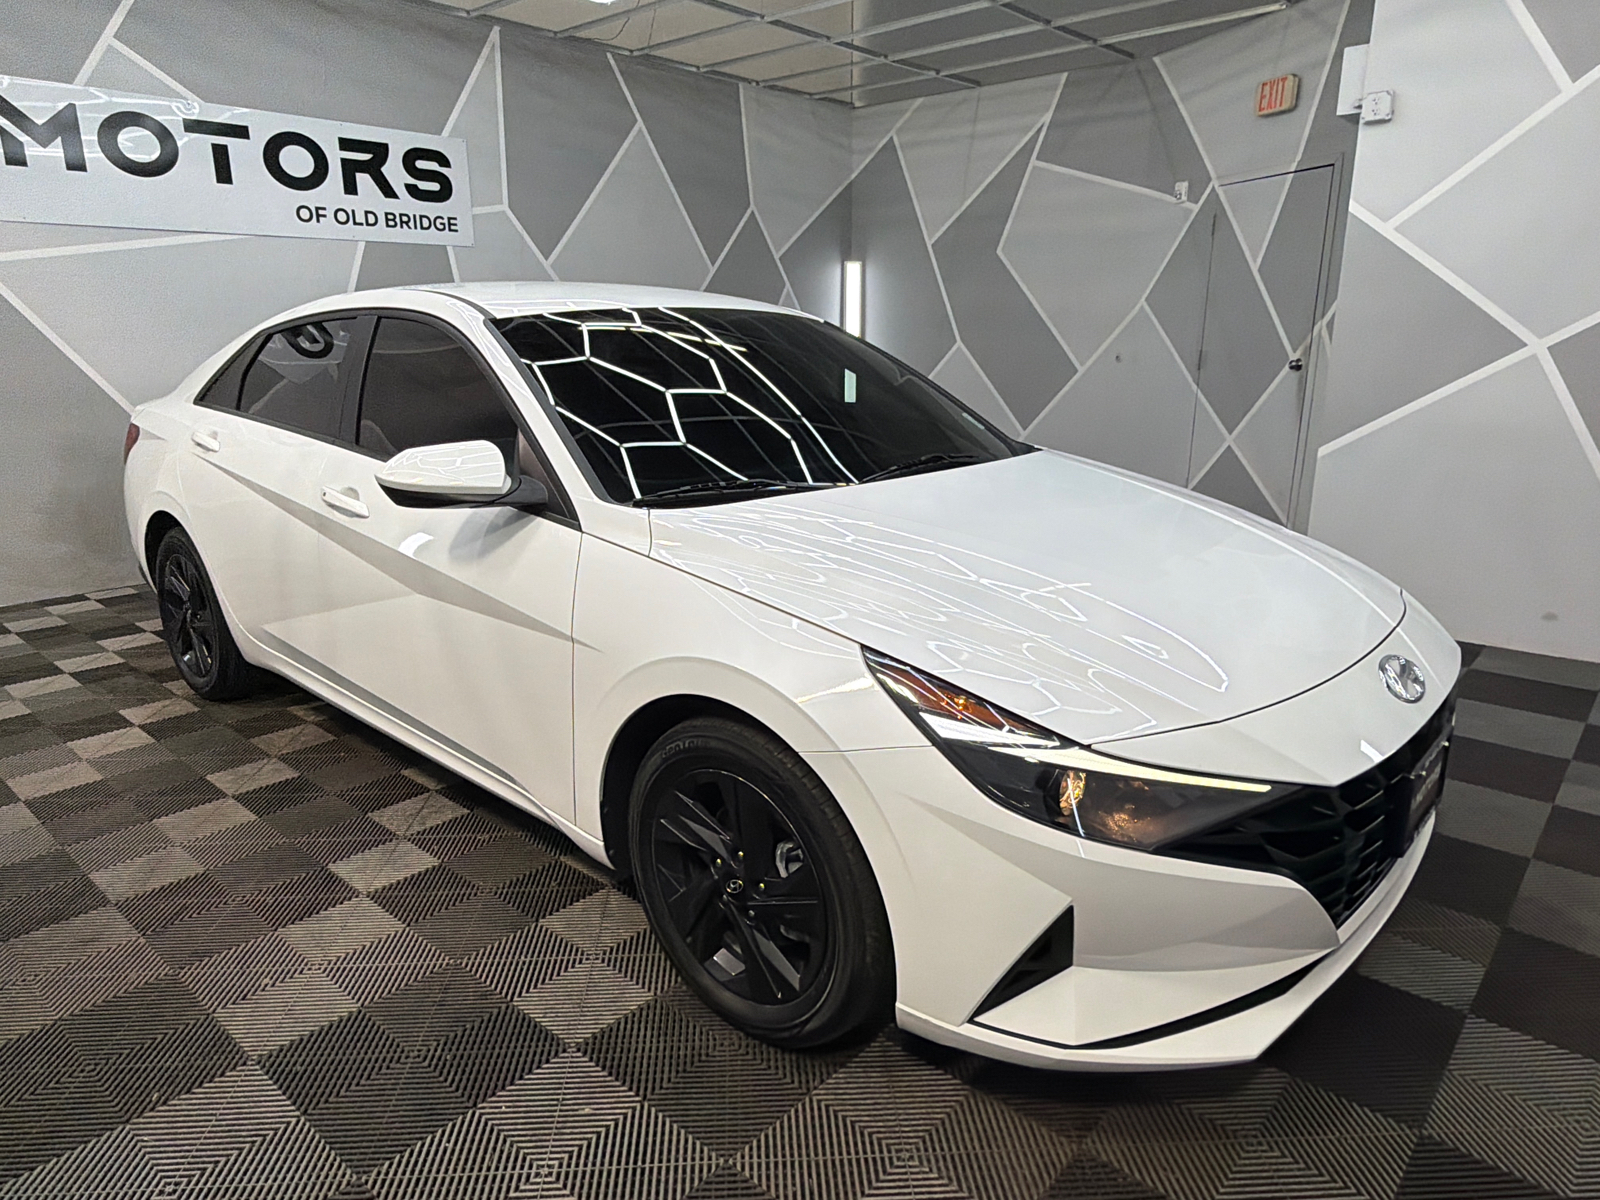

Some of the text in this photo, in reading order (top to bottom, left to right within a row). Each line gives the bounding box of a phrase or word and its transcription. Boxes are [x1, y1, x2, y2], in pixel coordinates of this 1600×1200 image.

[1258, 76, 1288, 112] EXIT
[0, 94, 454, 203] MOTORS
[295, 205, 459, 233] OF OLD BRIDGE
